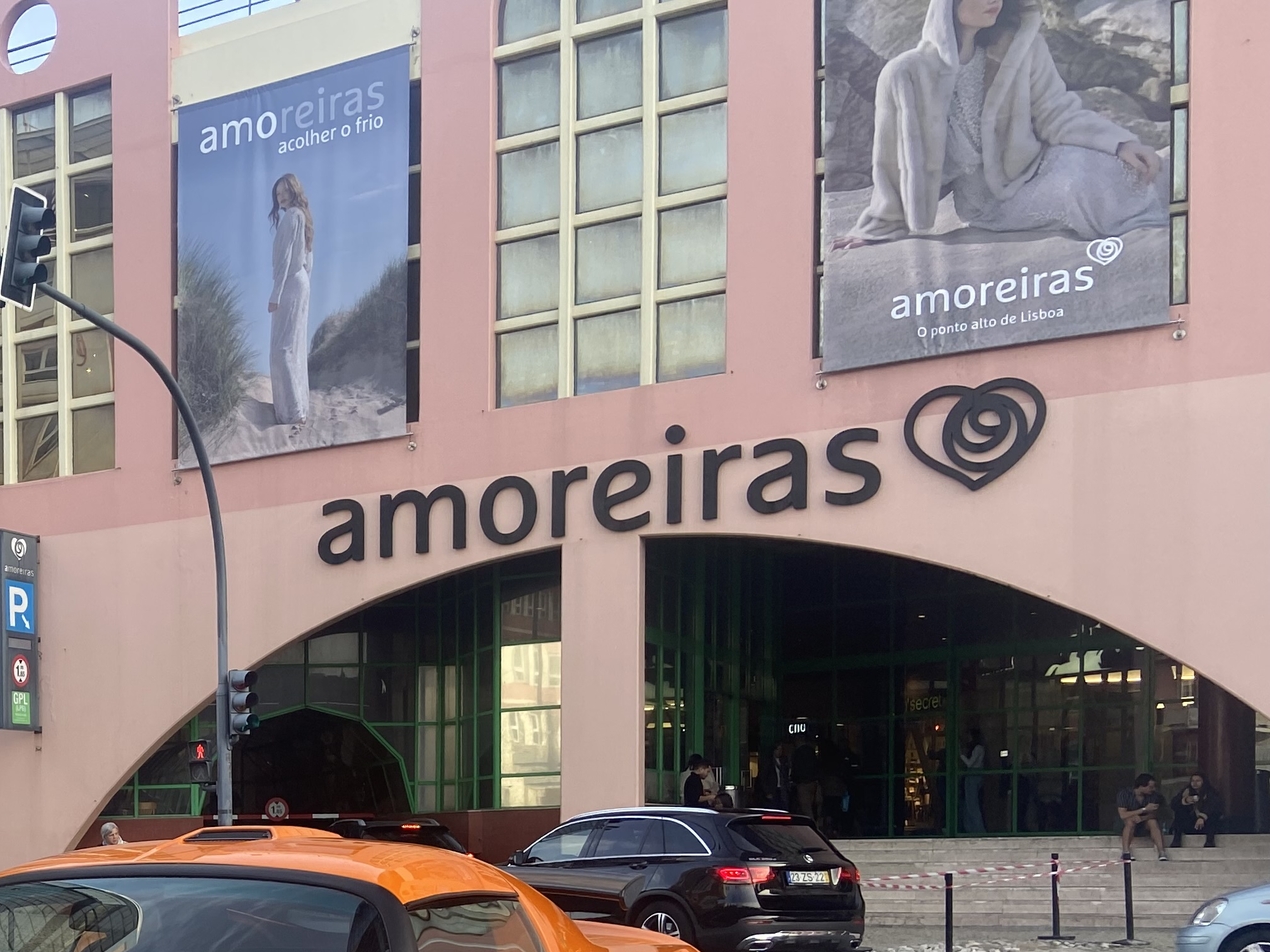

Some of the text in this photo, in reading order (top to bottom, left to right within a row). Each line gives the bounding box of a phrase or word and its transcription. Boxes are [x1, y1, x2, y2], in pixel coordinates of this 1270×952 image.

[199, 81, 385, 154] amoreiras
[278, 113, 384, 154] acolher o frio
[890, 266, 1094, 320] amoreiras
[917, 306, 1064, 339] O ponto alto de Lisboa
[317, 423, 882, 566] amoreiras
[4, 565, 35, 577] amoreiras
[9, 586, 29, 627] P
[13, 692, 28, 705] GPL
